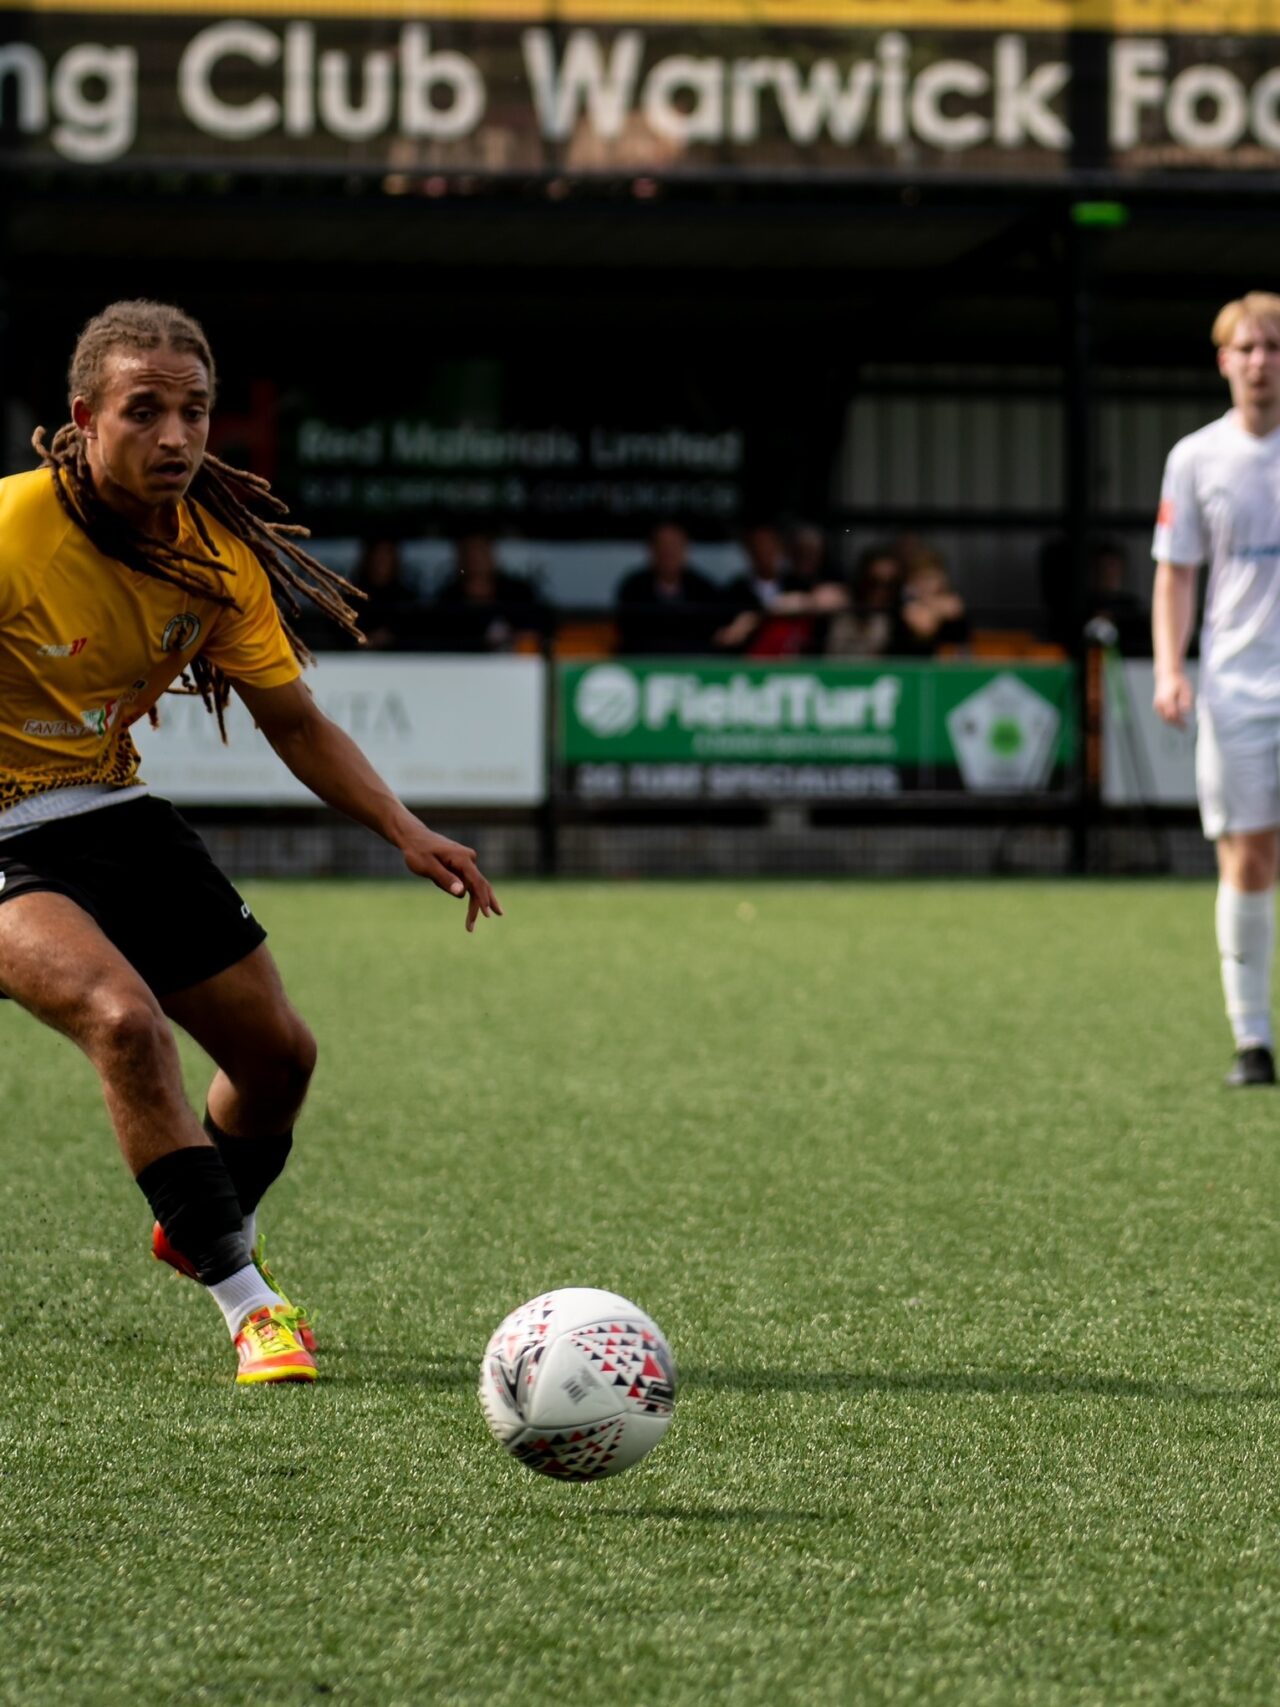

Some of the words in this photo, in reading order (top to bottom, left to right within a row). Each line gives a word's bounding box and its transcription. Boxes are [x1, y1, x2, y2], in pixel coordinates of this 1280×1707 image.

[180, 21, 485, 140] Club
[524, 27, 1069, 150] Warwick
[591, 428, 742, 470] Limited
[643, 672, 901, 729] FieldTurf
[707, 763, 899, 798] SPECIALISTS
